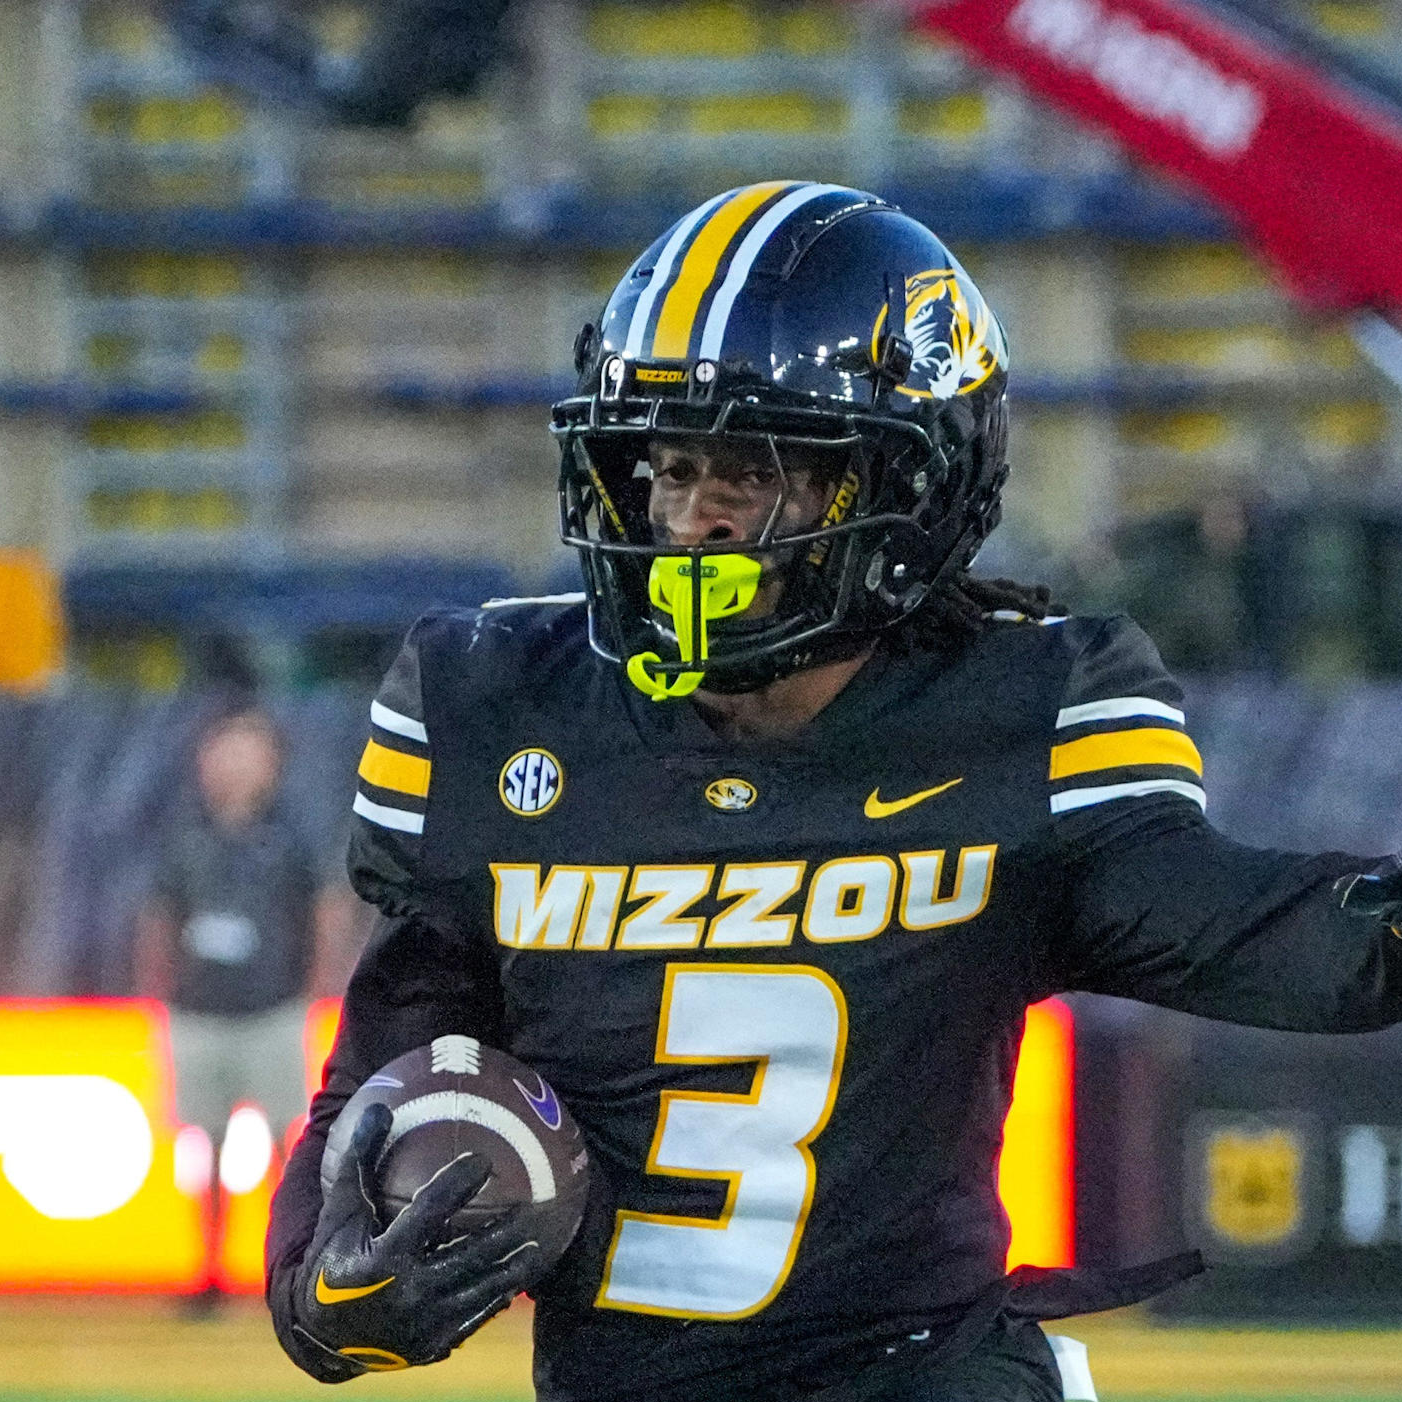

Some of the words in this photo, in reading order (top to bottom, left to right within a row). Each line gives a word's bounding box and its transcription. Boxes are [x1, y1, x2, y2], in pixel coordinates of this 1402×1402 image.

[504, 751, 559, 813] SEC
[489, 844, 998, 951] MIZZOU
[593, 963, 849, 1321] 3
